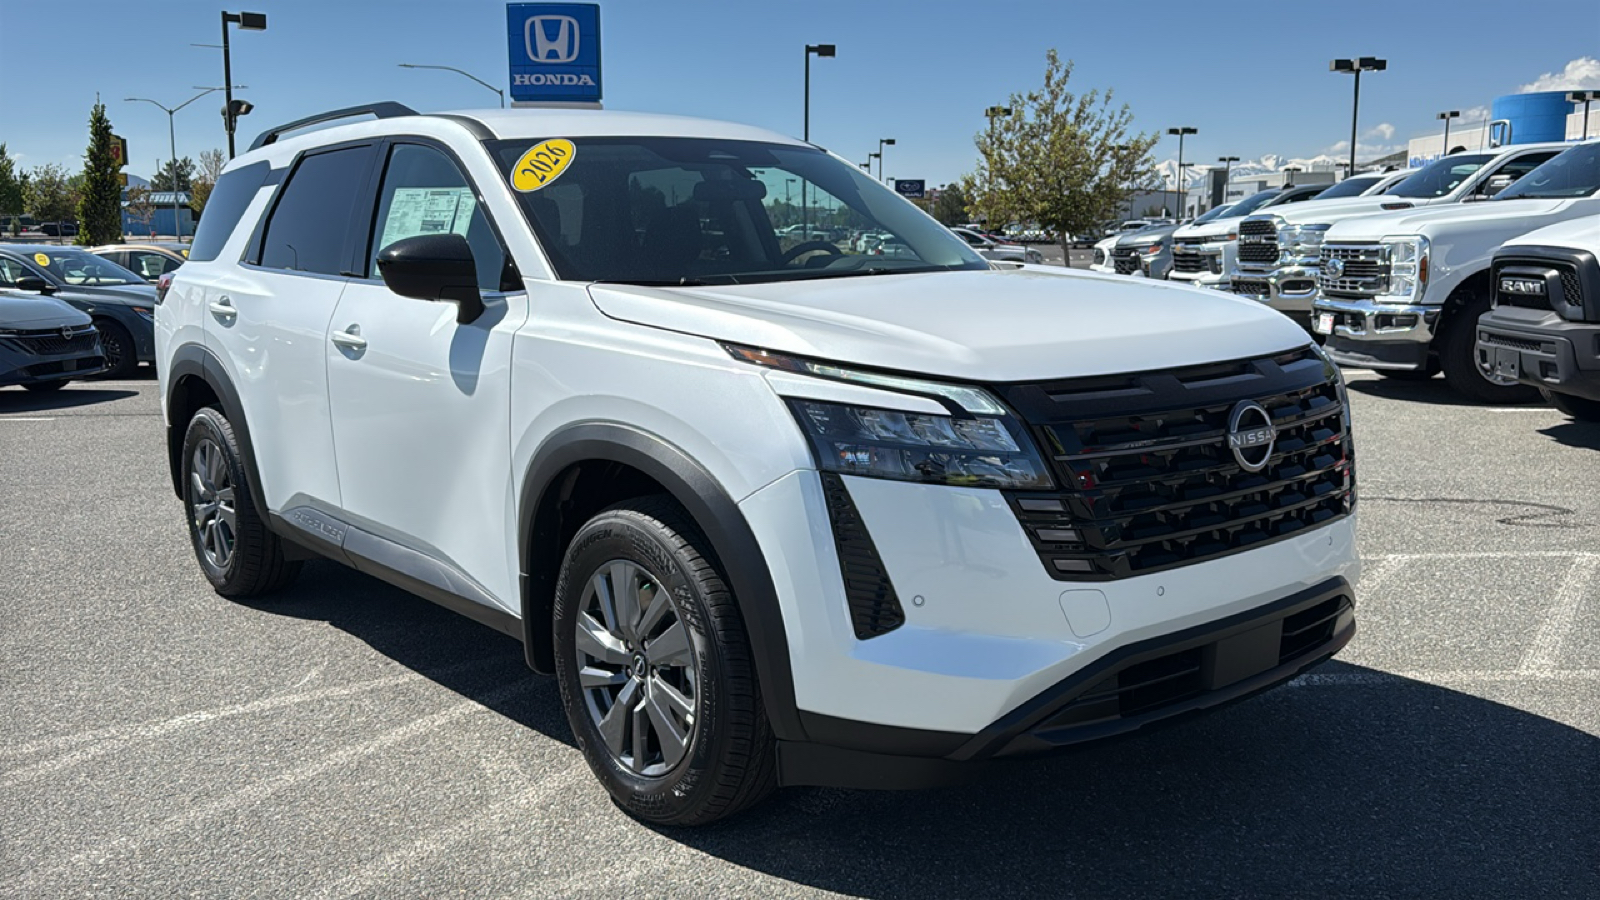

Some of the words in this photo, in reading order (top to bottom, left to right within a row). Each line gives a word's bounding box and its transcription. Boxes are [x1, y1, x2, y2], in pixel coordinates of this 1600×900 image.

[513, 74, 596, 86] HONDA
[521, 143, 566, 183] 2026
[1501, 280, 1541, 292] RAM
